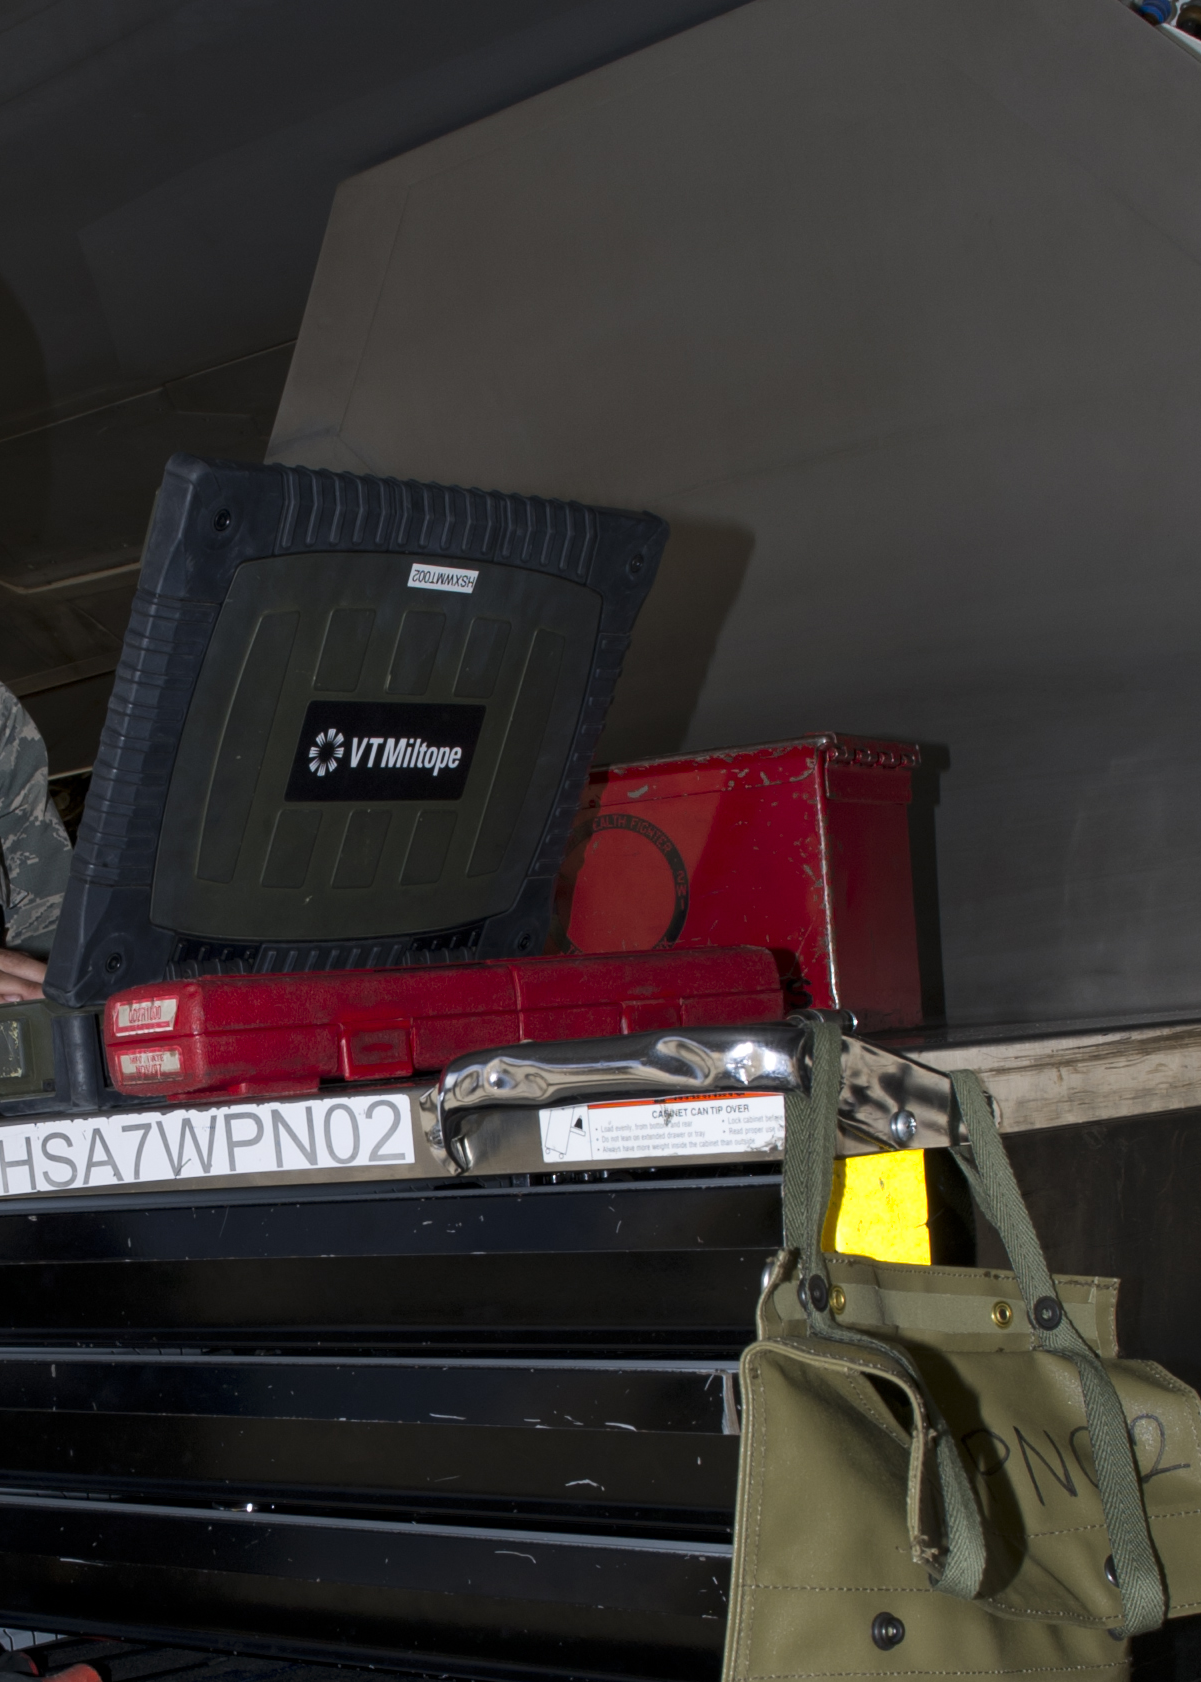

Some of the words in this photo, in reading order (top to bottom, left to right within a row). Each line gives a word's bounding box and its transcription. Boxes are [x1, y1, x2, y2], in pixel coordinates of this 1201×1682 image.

[690, 1107, 709, 1116] CAN
[709, 1106, 724, 1115] TIP
[725, 1104, 750, 1113] OVER
